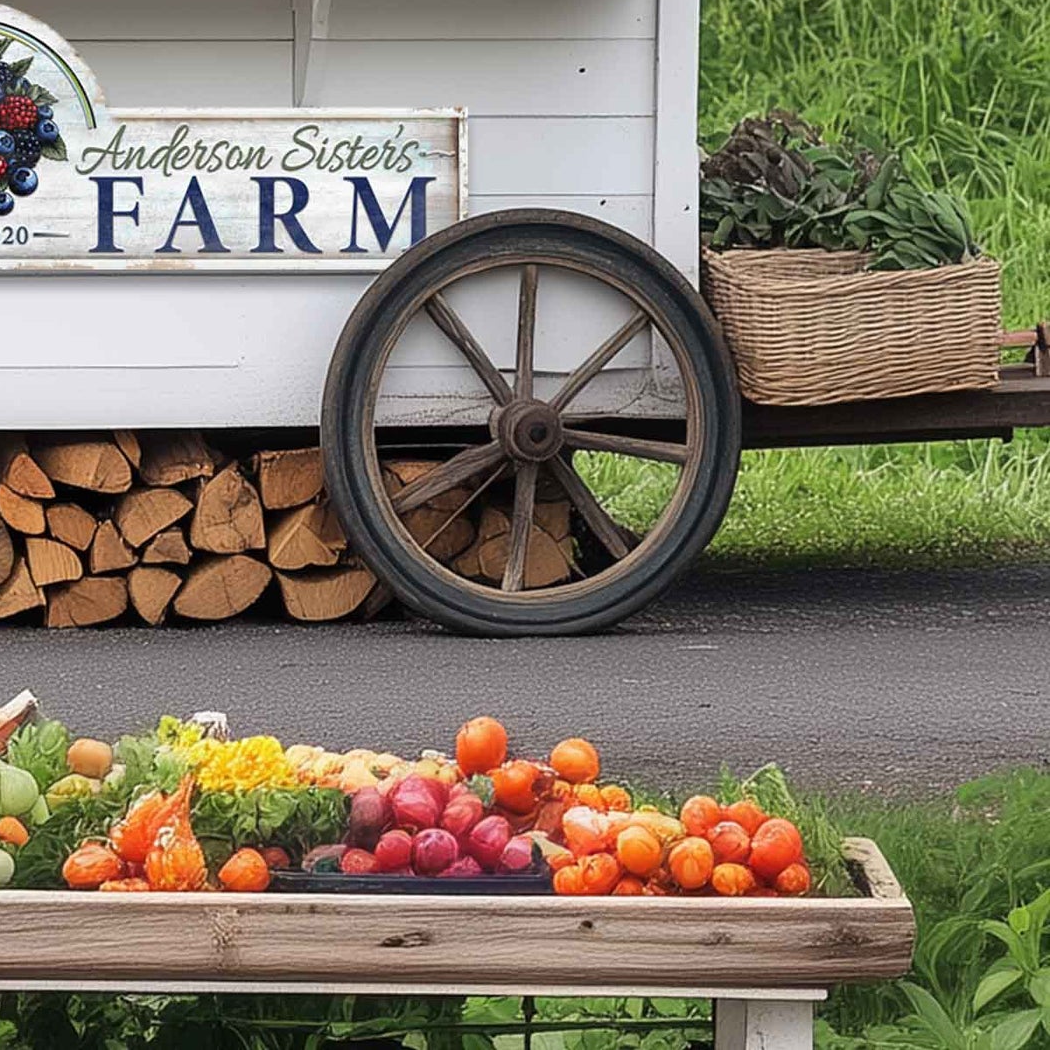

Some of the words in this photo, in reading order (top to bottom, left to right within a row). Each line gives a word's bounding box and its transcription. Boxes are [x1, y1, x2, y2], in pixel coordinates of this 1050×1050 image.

[75, 124, 273, 177] Anderson
[281, 124, 420, 172] Sister's
[88, 175, 437, 253] FARM
